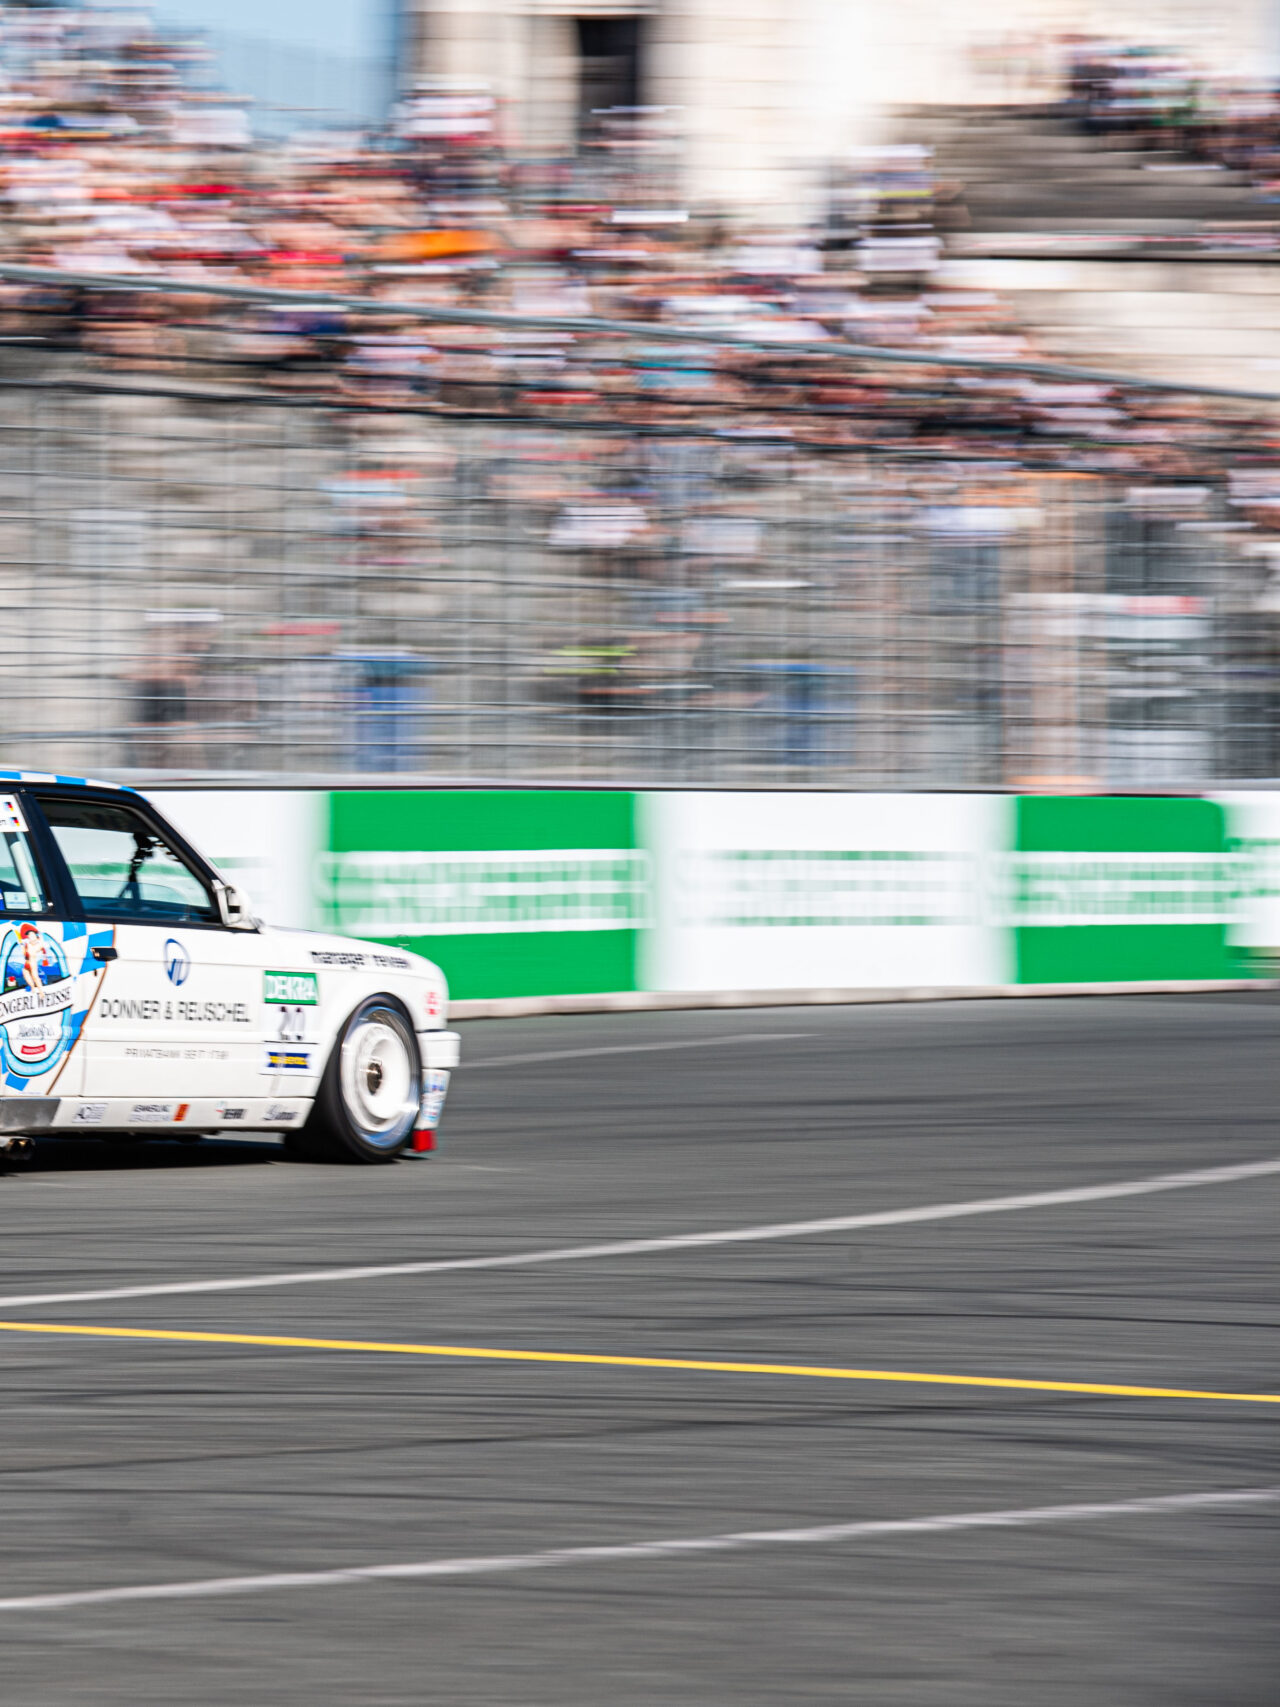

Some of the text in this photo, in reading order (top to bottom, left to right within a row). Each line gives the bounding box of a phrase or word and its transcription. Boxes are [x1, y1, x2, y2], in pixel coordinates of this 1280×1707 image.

[265, 974, 316, 1001] DEKRA
[100, 998, 251, 1022] DONNER & REUSCHEL
